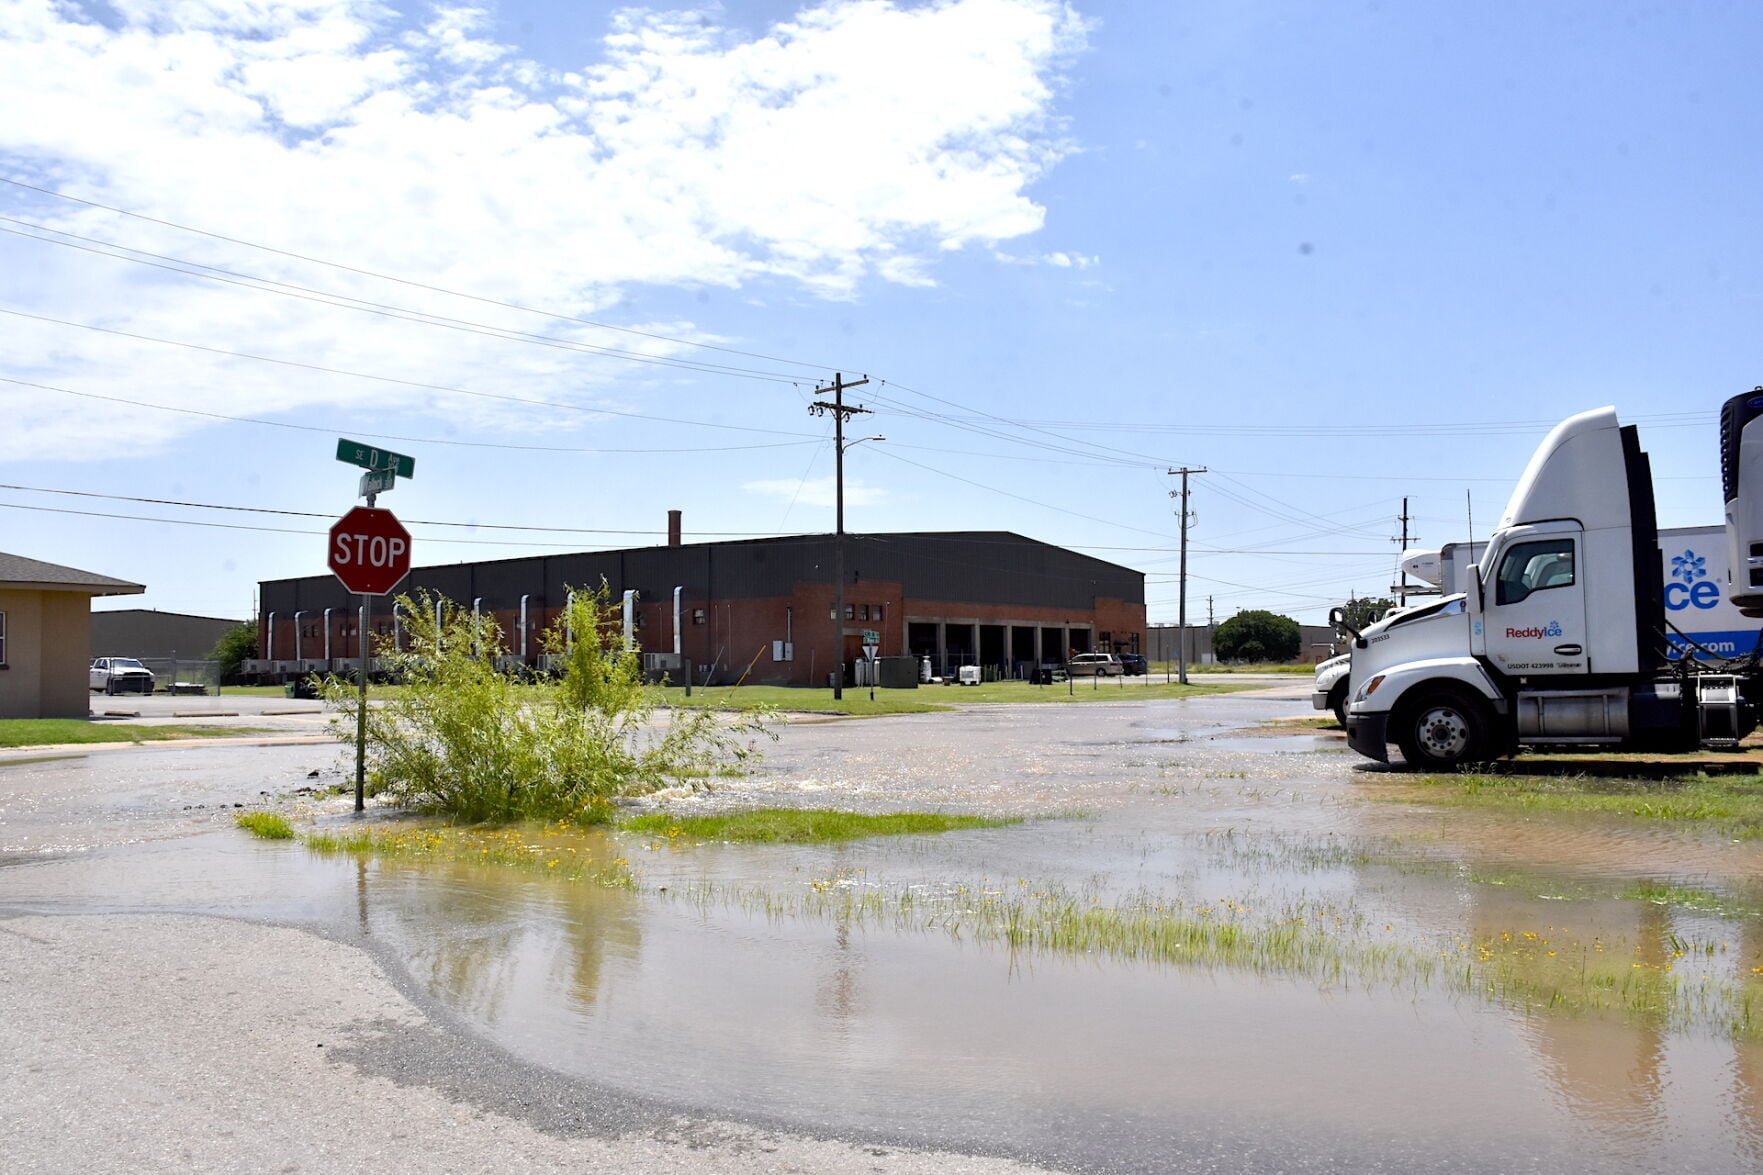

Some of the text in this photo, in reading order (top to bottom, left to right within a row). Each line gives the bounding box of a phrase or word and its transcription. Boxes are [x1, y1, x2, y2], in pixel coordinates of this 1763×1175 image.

[355, 449, 364, 460] SE
[369, 449, 379, 467] D
[334, 532, 406, 568] STOP
